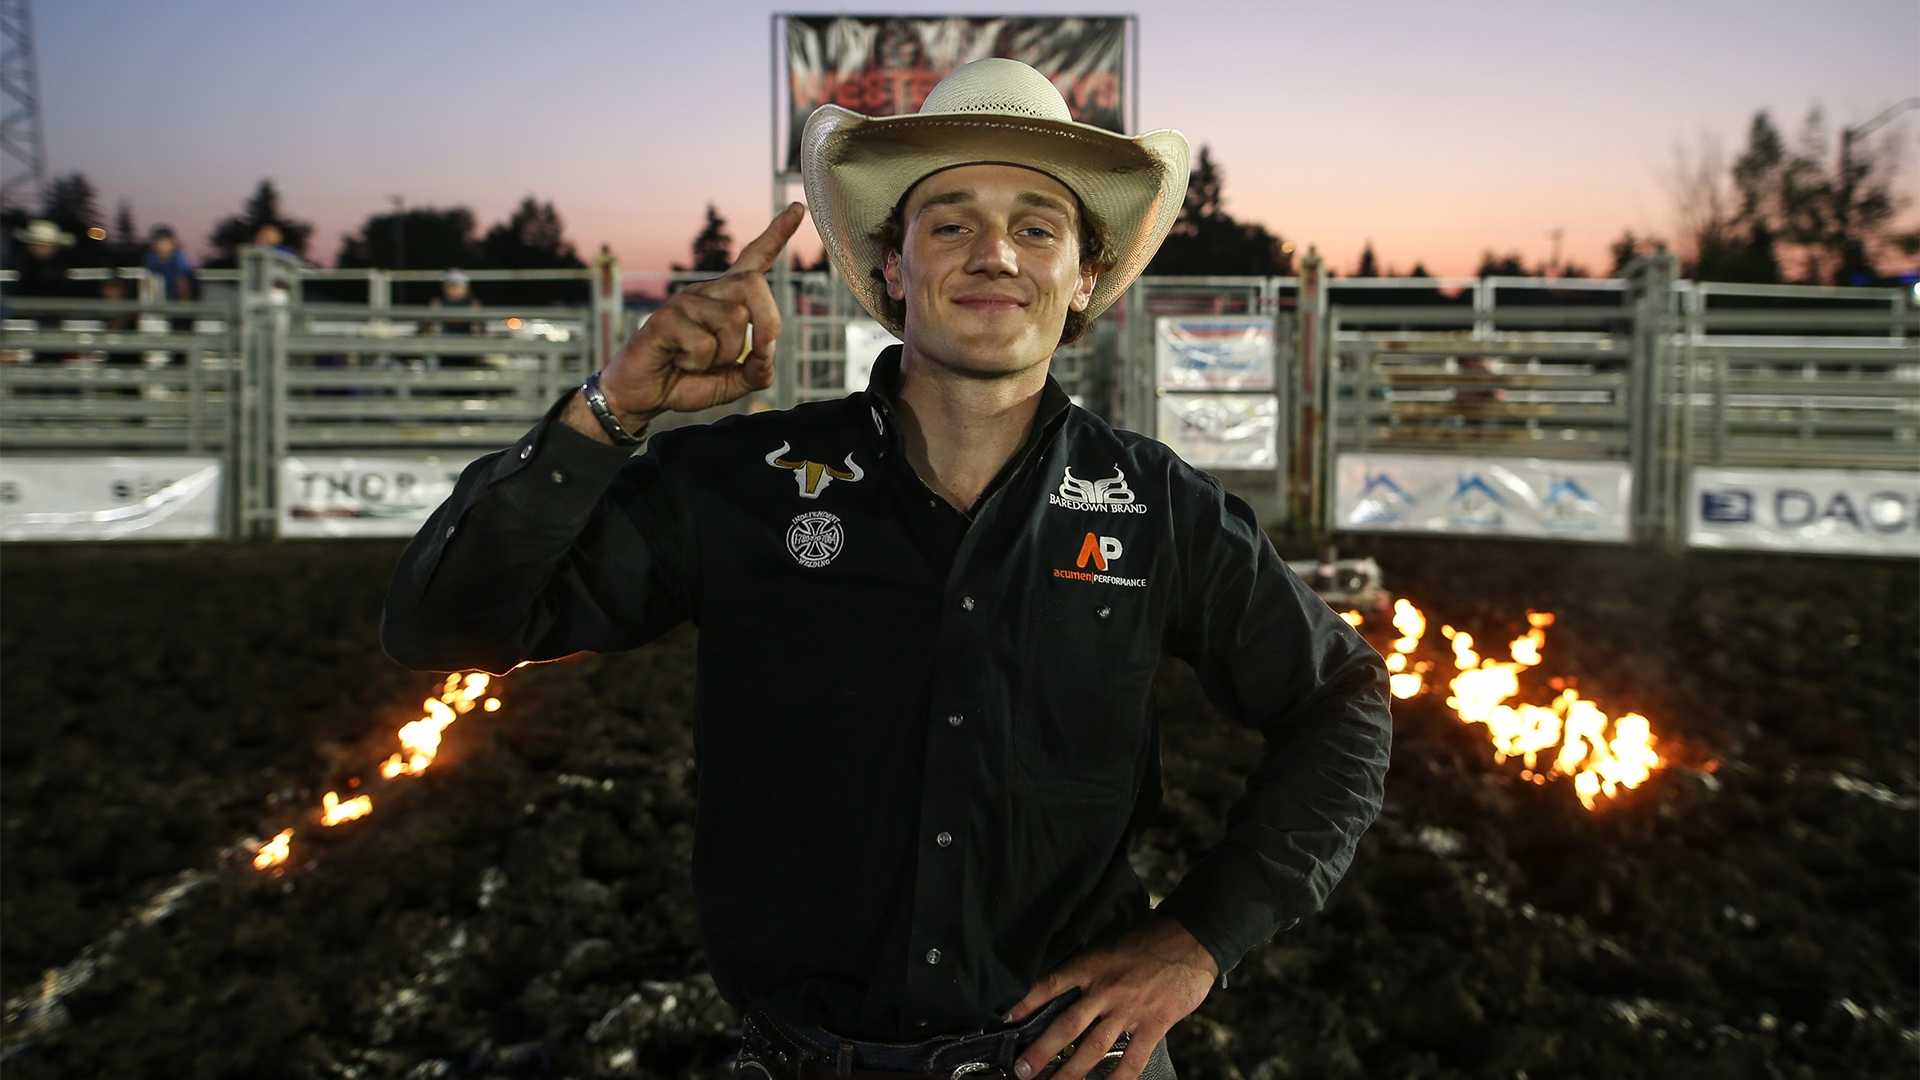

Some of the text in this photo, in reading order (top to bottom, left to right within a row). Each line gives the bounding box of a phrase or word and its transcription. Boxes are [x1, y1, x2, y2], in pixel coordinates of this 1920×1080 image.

[1049, 493, 1147, 514] BAREDOWN BRAND
[1775, 488, 1920, 533] DAC
